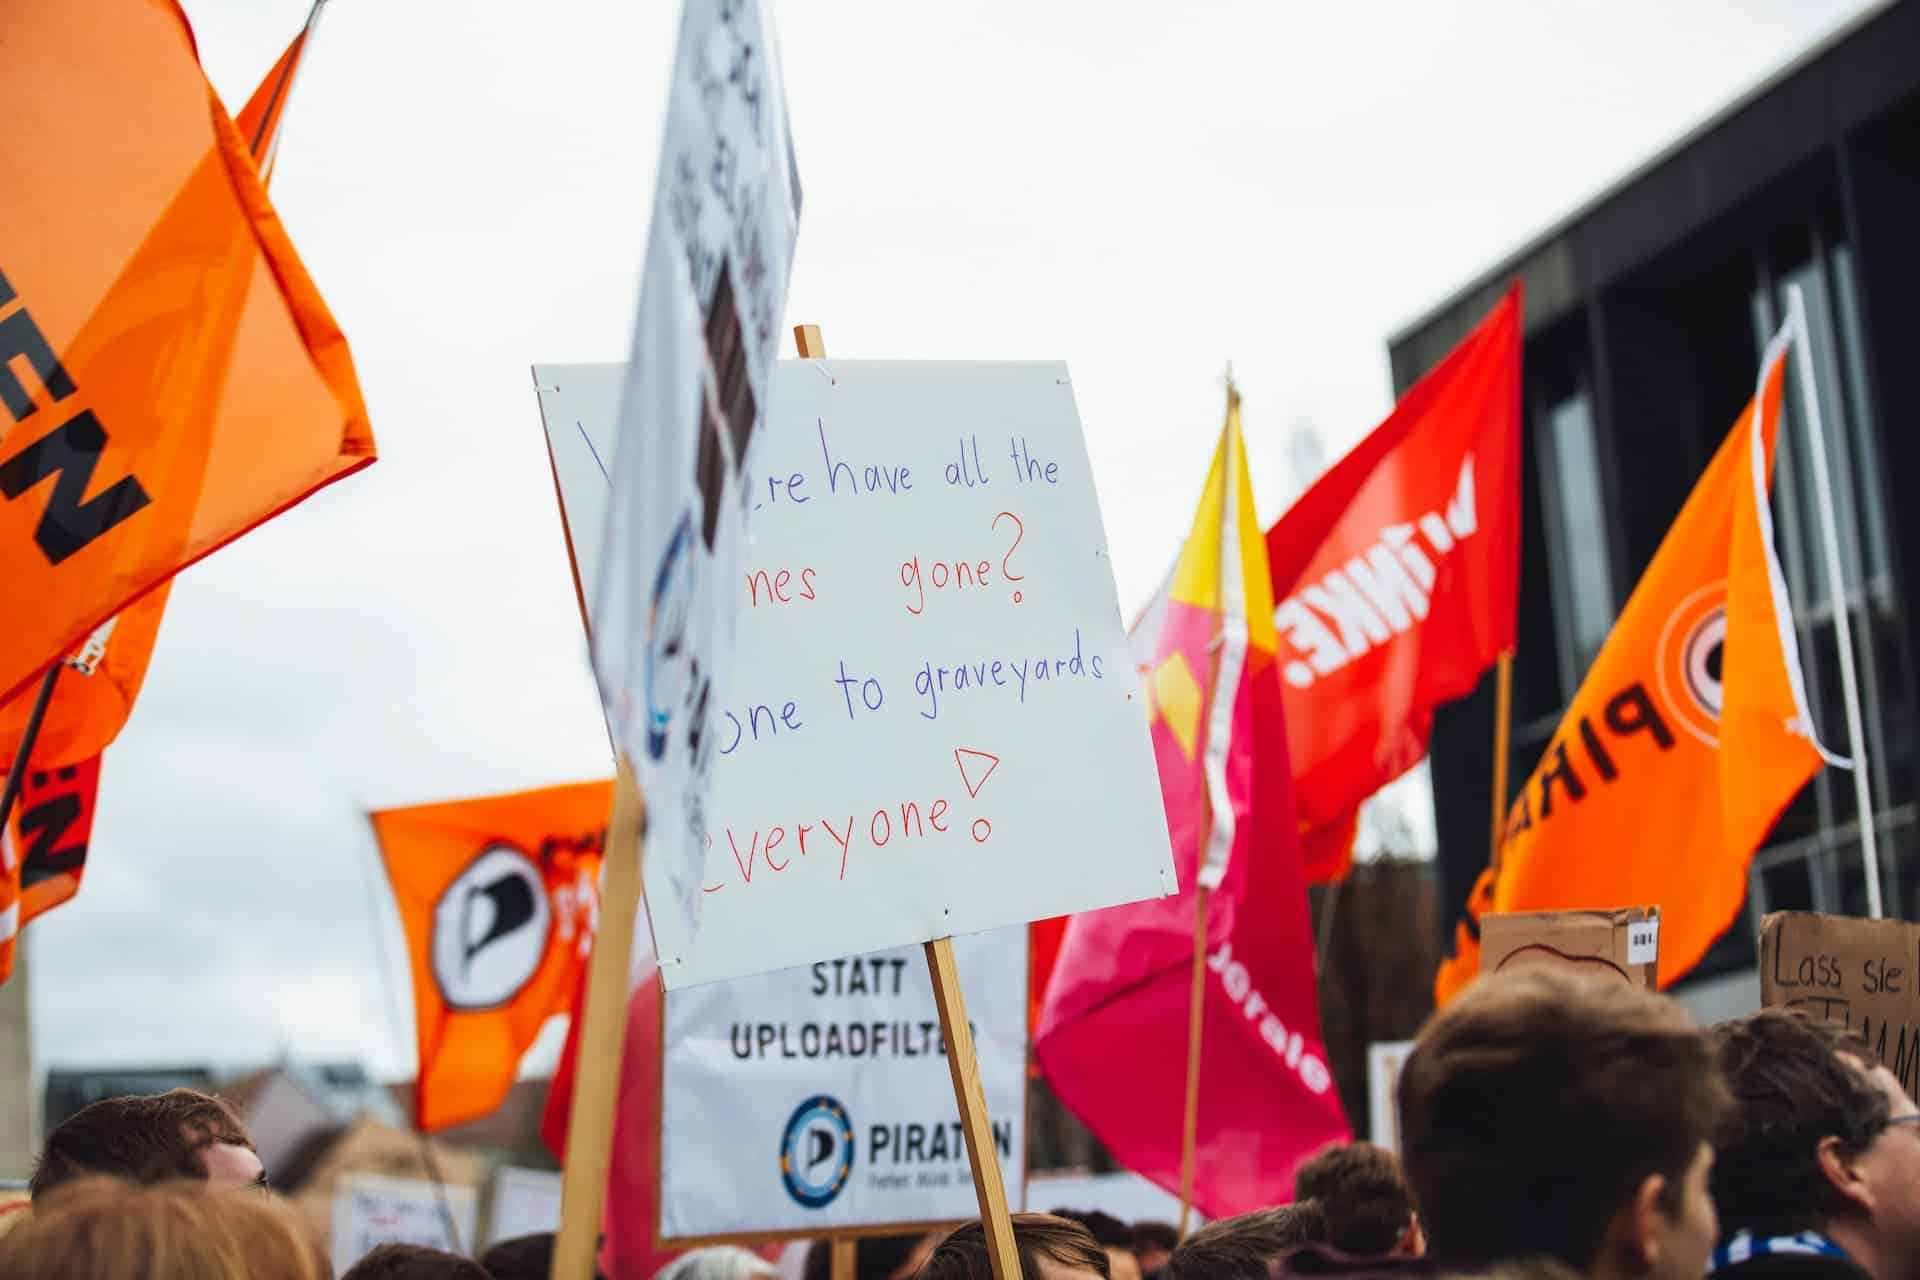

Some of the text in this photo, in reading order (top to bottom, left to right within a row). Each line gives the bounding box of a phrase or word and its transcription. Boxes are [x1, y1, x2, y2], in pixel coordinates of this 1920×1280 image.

[816, 417, 913, 496] have
[945, 435, 988, 487] all
[1010, 437, 1059, 485] the
[901, 511, 1025, 615] gone?
[720, 702, 803, 754] one
[834, 660, 884, 720] to
[915, 627, 1104, 720] graveyards
[811, 959, 907, 997] STATT
[1774, 919, 1841, 989] Lass
[868, 1120, 1012, 1165] PIRATN
